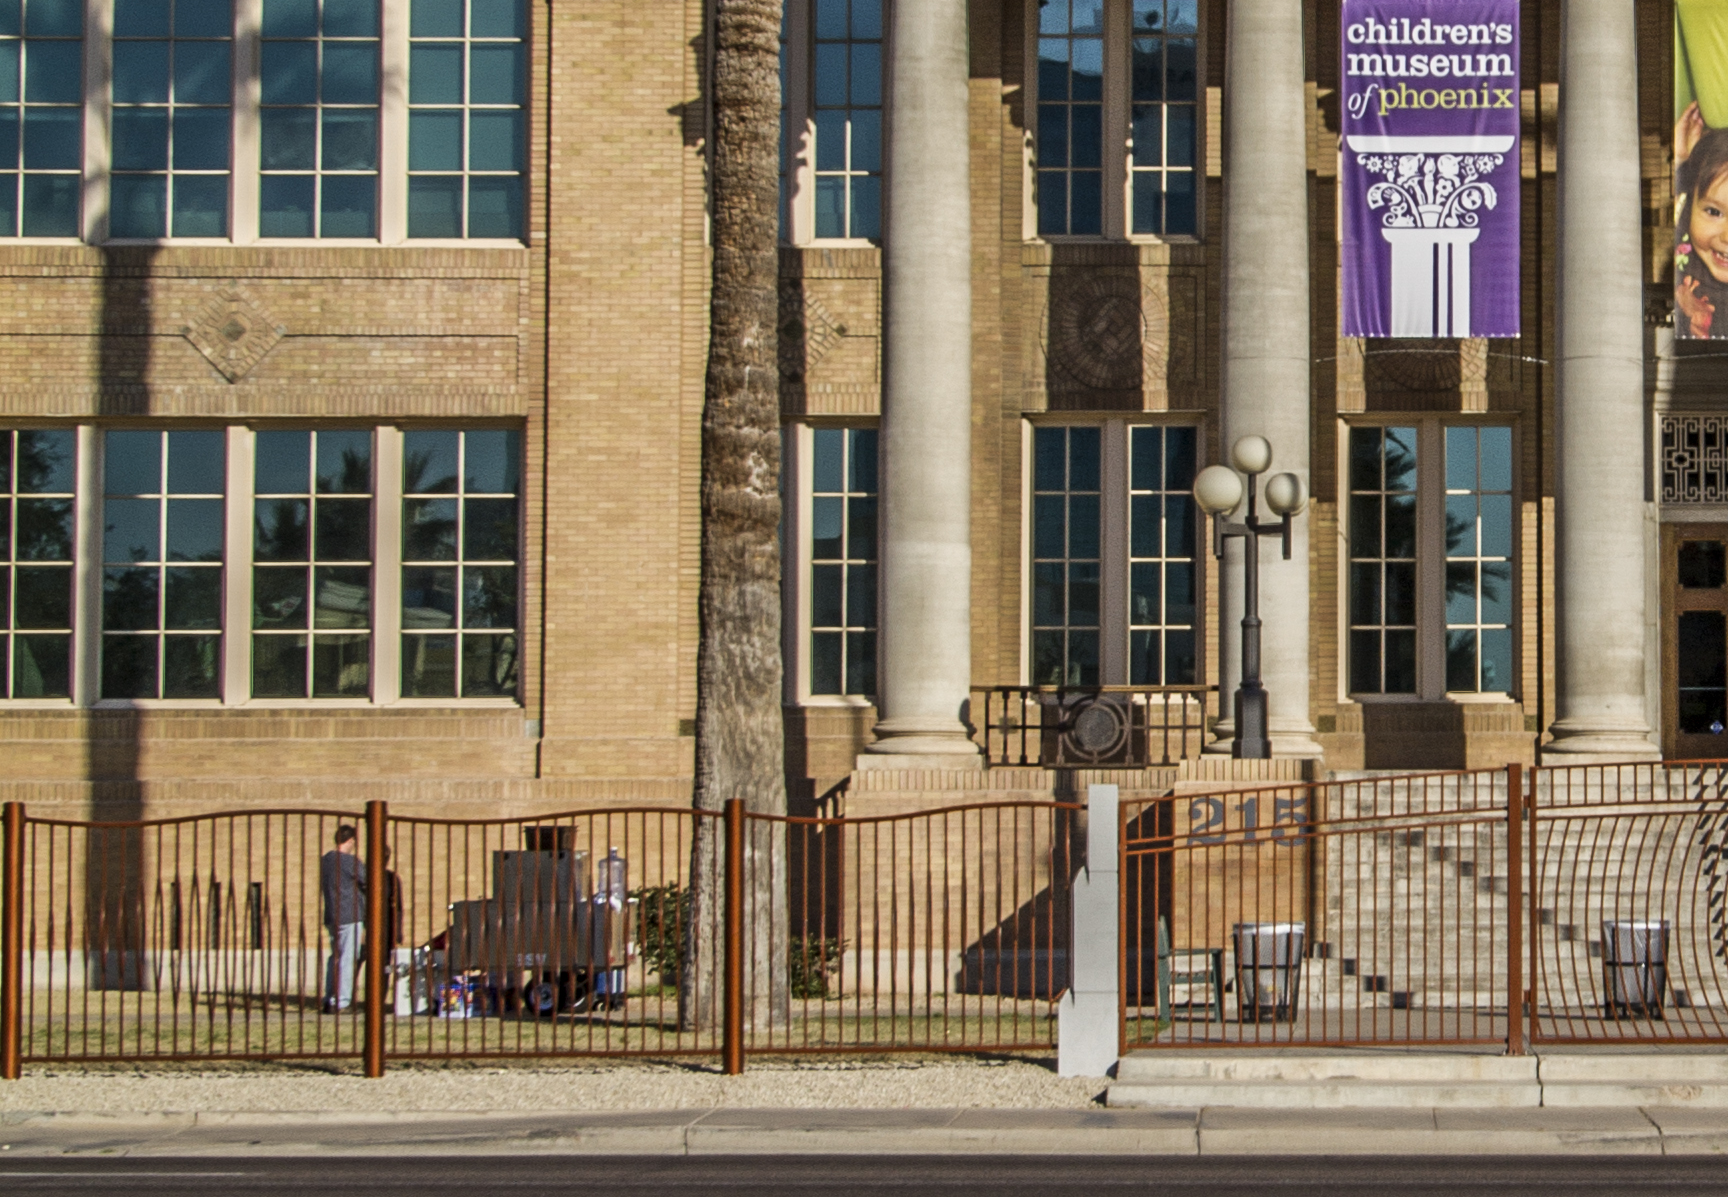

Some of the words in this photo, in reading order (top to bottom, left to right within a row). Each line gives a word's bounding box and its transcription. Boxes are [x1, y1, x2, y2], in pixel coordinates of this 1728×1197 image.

[1347, 17, 1513, 45] children's
[1347, 53, 1515, 78] museum
[1347, 83, 1378, 120] of
[1378, 82, 1515, 116] phoenix
[1186, 796, 1308, 848] 215
